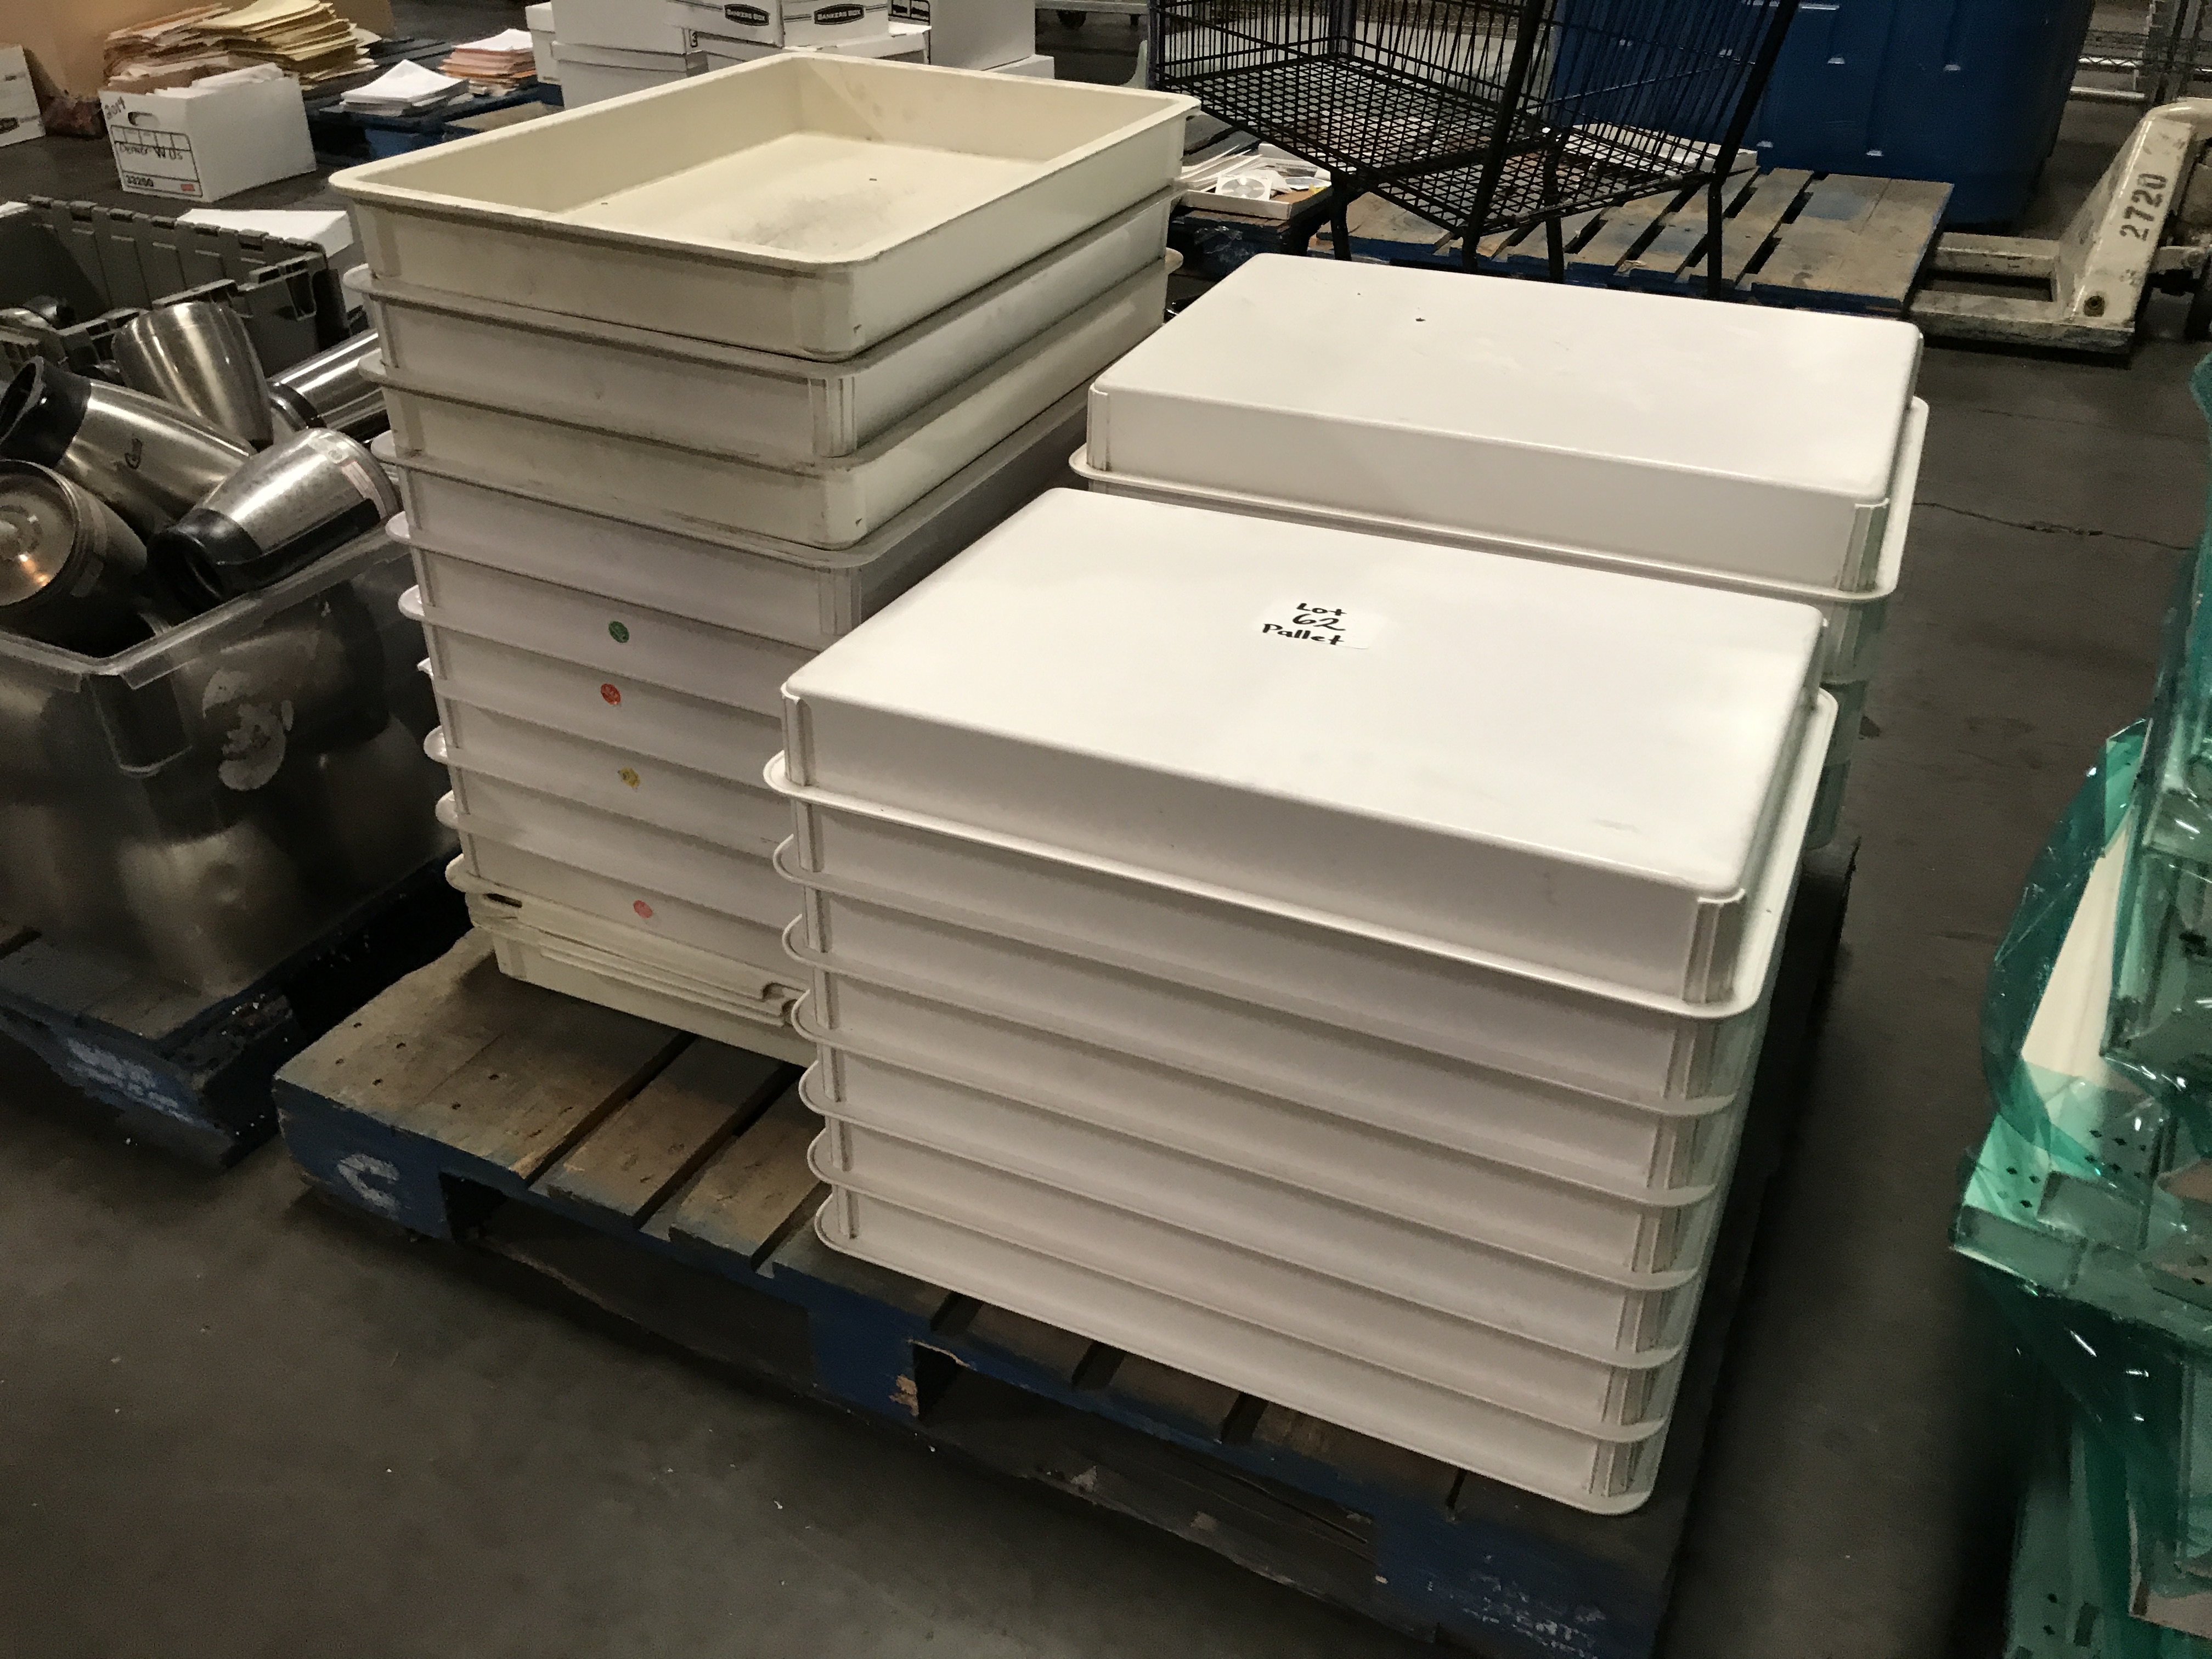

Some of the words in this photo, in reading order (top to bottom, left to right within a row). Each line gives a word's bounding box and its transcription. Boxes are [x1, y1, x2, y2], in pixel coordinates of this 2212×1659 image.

[2119, 172, 2168, 241] 2720
[1295, 602, 1347, 617] Lot
[1292, 613, 1346, 631] 62
[1262, 623, 1345, 646] Pallet
